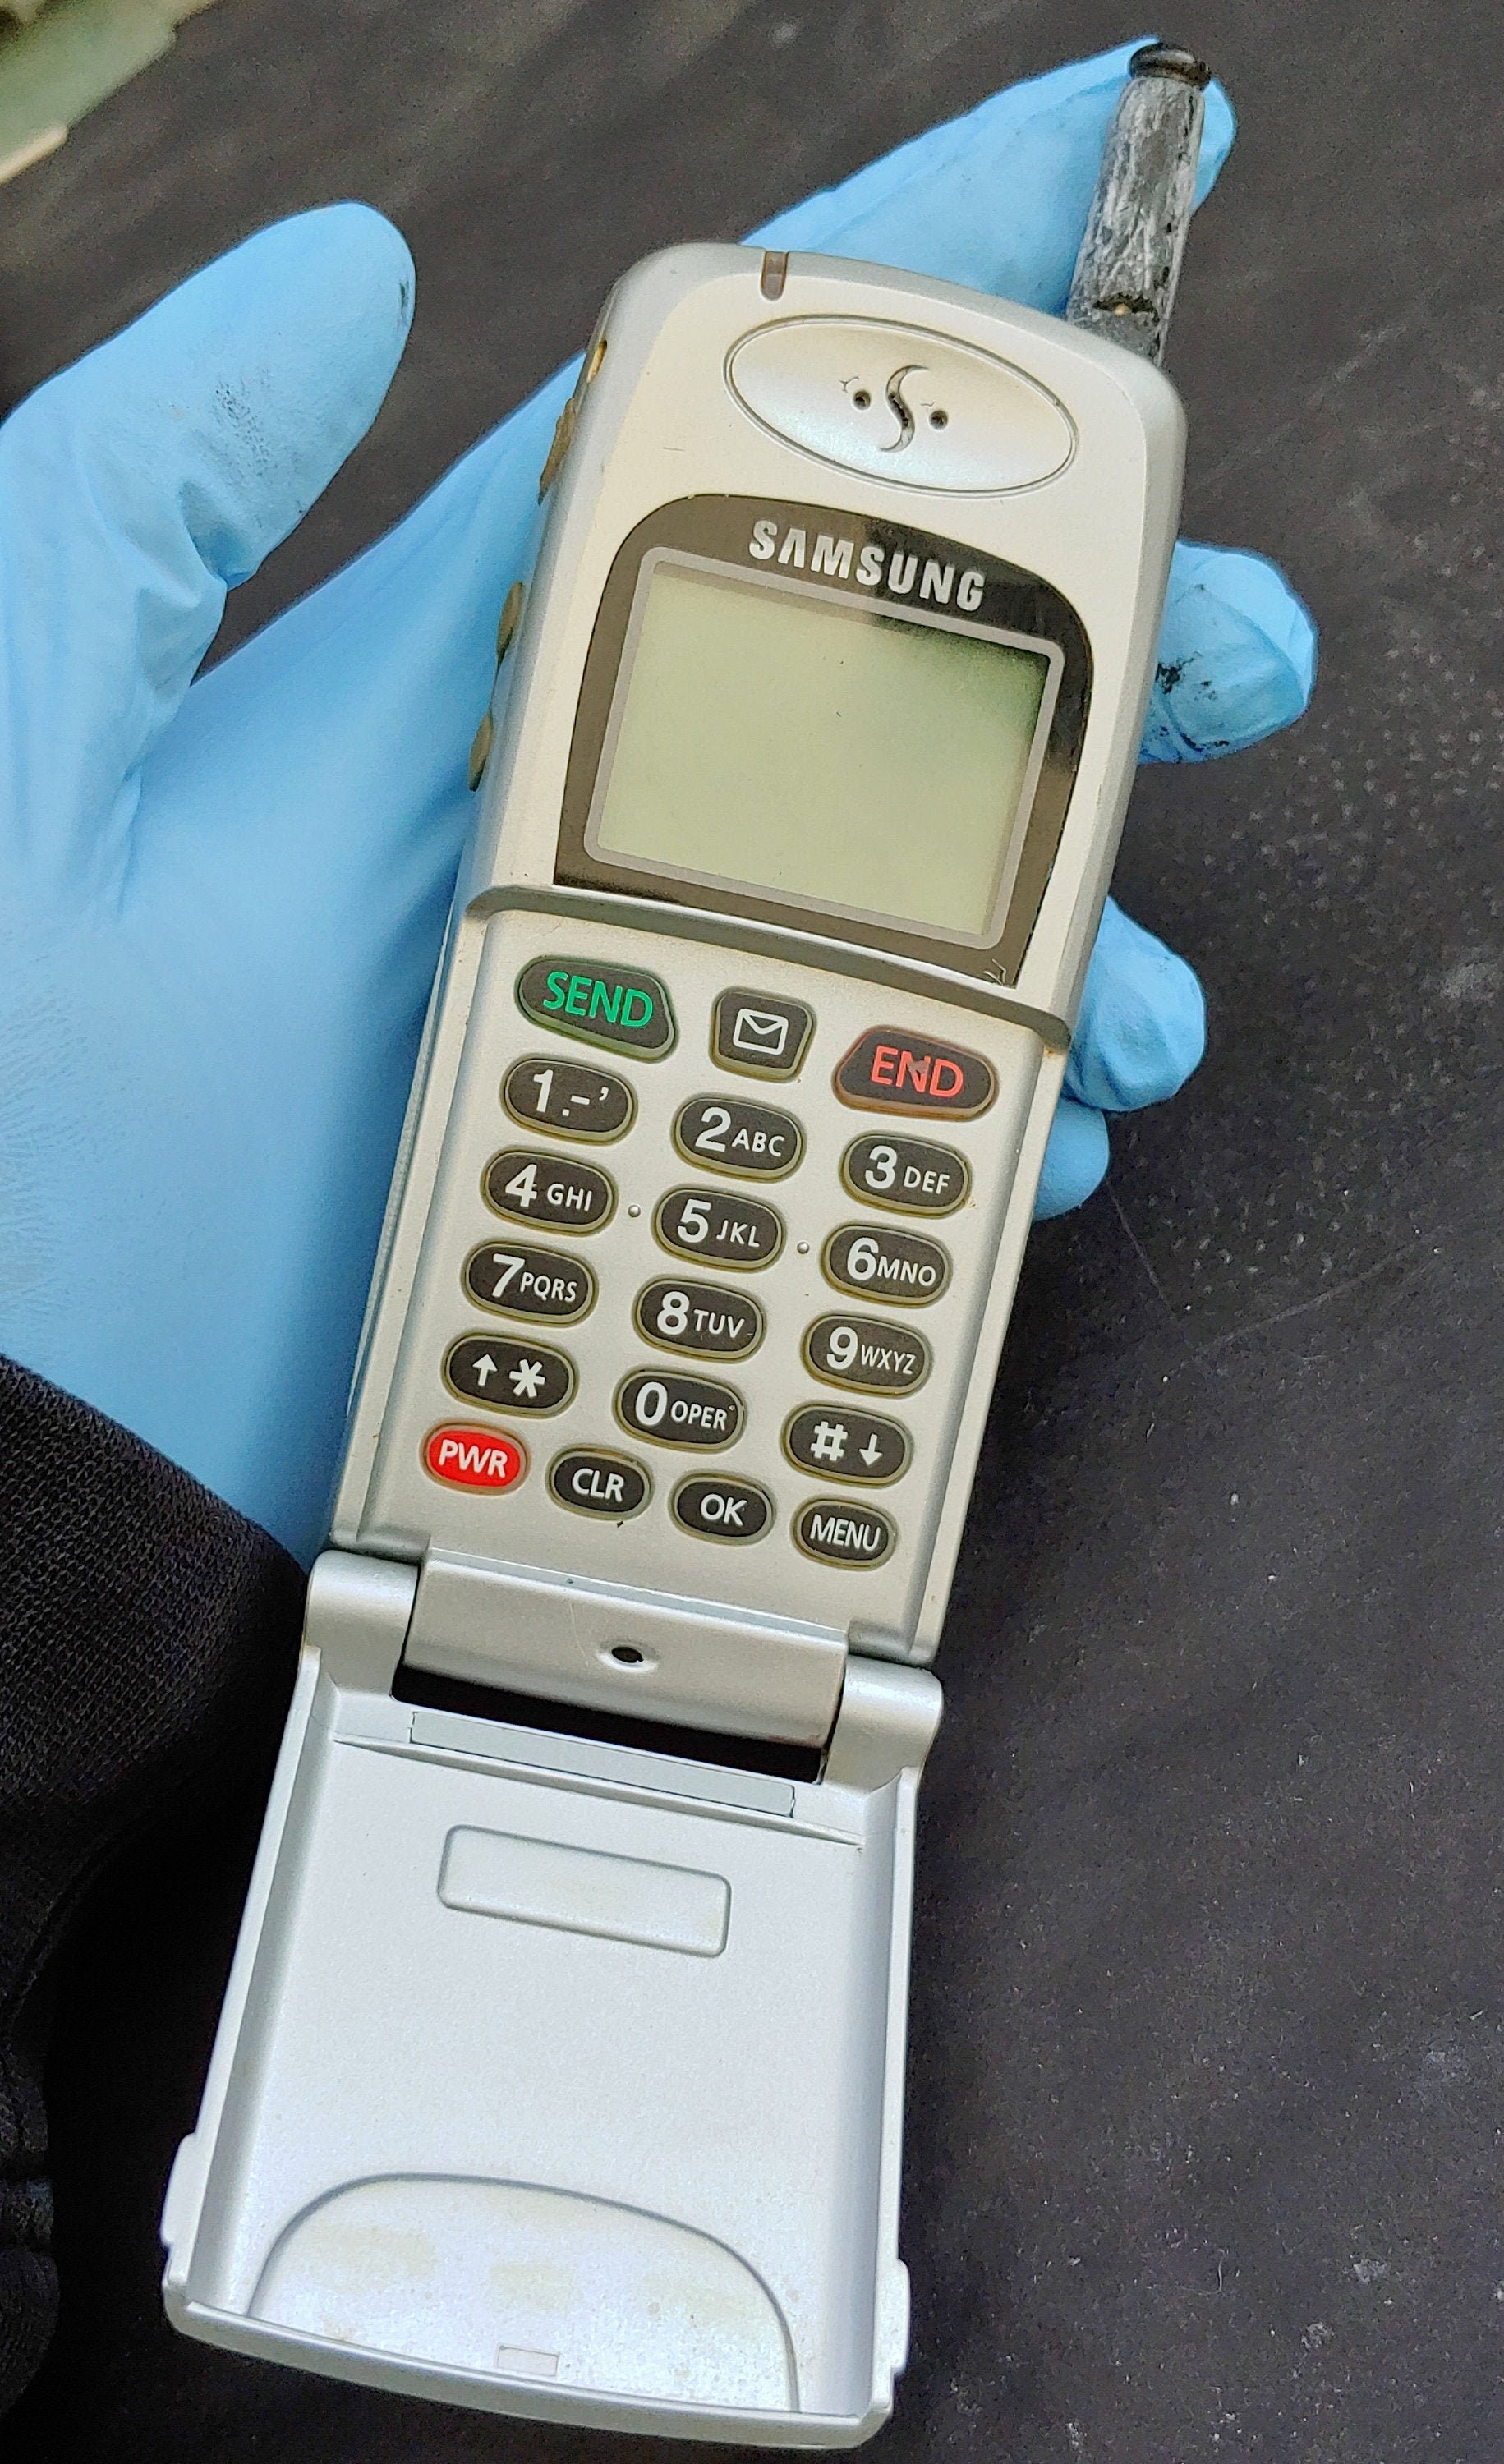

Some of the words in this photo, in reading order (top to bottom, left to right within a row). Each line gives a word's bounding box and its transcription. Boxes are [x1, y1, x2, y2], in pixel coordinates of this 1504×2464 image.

[748, 519, 986, 612] SAMSUNG
[542, 970, 654, 1028] SEND
[871, 1046, 964, 1097] END
[695, 1106, 731, 1152] 2
[731, 1128, 784, 1157] ABC
[505, 1164, 537, 1207] 4
[546, 1183, 592, 1211] GHI
[865, 1145, 898, 1189] 3
[903, 1165, 950, 1195] DEF
[677, 1198, 711, 1243] 5
[715, 1220, 760, 1248] JKL
[657, 1291, 690, 1335] 8
[693, 1308, 745, 1339] TUV
[826, 1326, 858, 1370] 9
[861, 1344, 916, 1375] WXYZ
[635, 1381, 668, 1426] 0
[670, 1400, 727, 1431] OPER
[439, 1439, 508, 1478] PWR
[573, 1468, 624, 1501] CLR
[700, 1493, 747, 1526] OK
[810, 1514, 881, 1552] MENU
